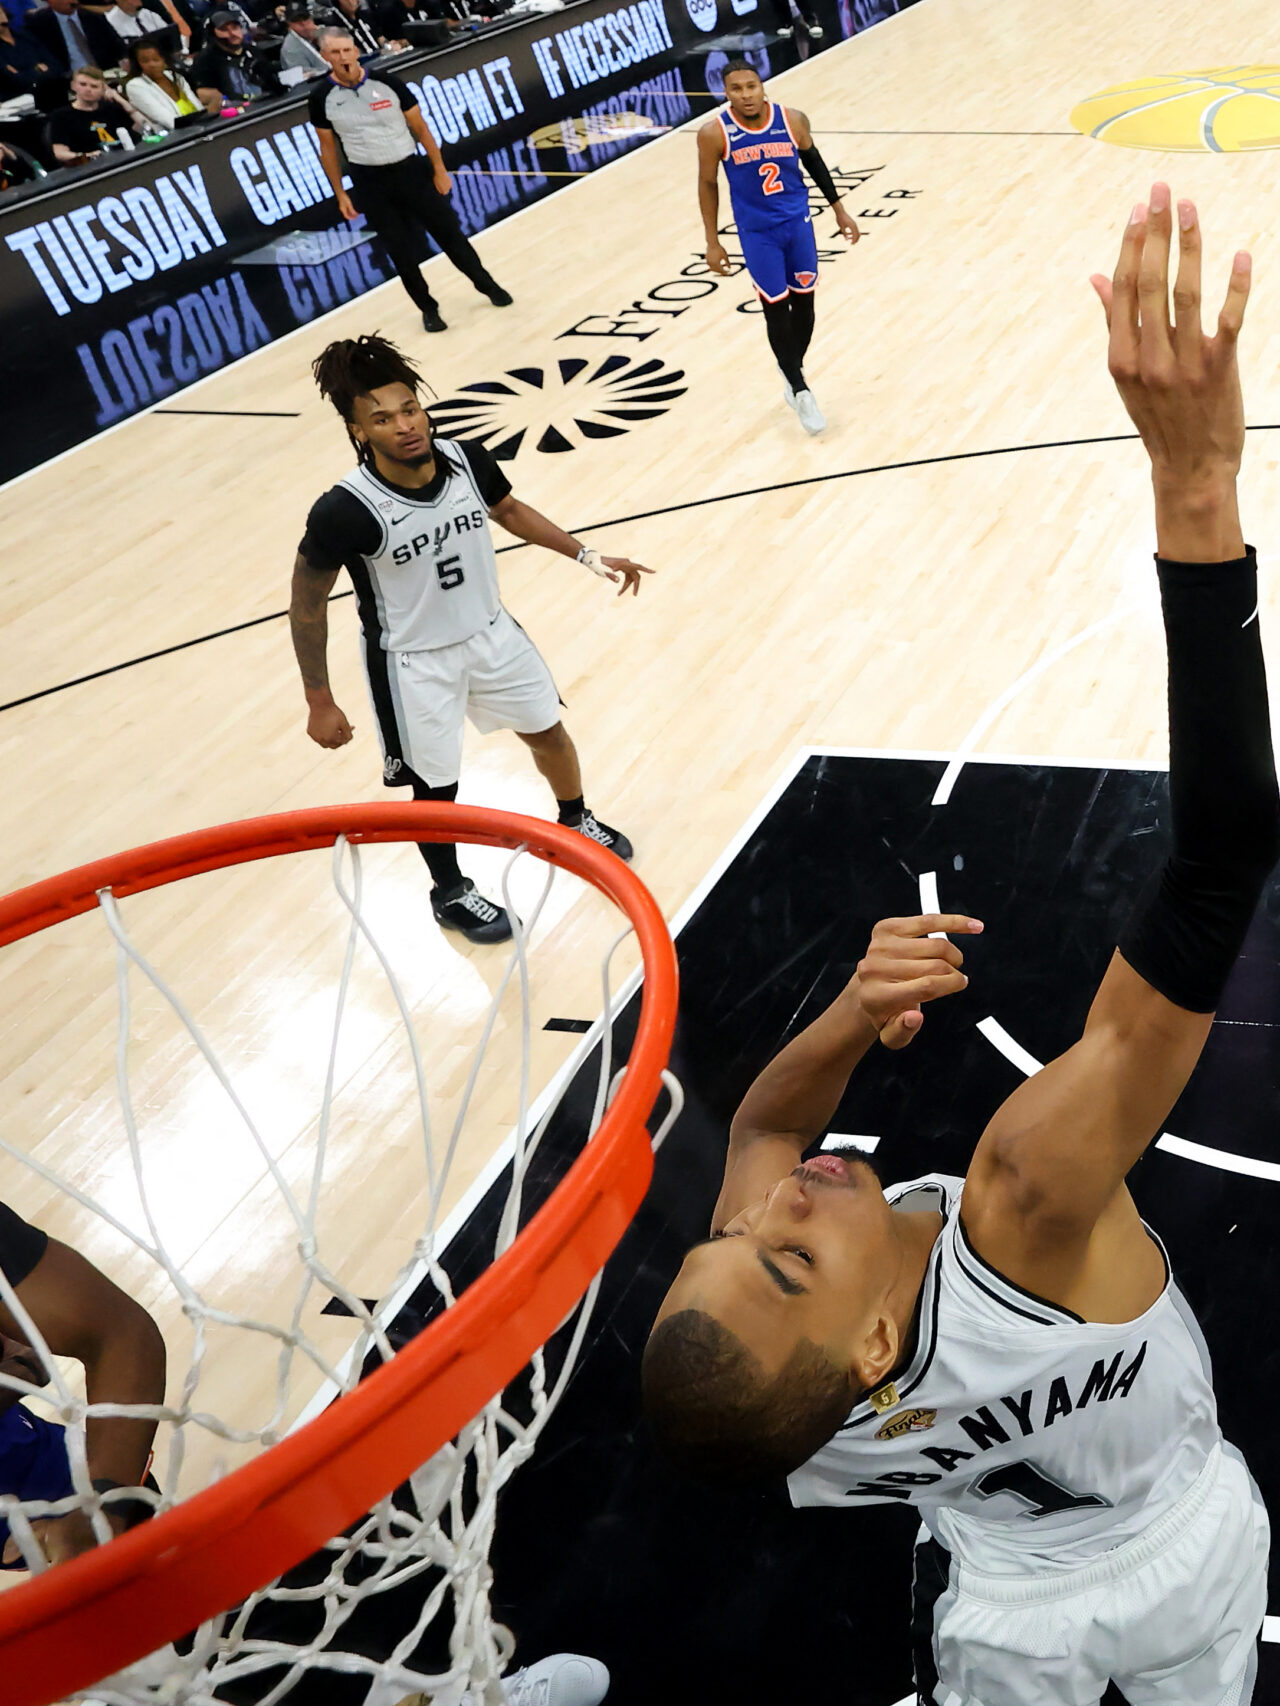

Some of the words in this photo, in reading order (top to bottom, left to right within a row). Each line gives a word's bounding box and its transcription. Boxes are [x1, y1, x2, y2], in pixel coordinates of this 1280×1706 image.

[4, 164, 228, 316] TUESDAY
[230, 121, 353, 226] GAM
[482, 56, 525, 121] ET
[531, 37, 566, 100] IF
[555, 0, 675, 90] NECESSARY
[731, 148, 762, 165] NEW
[758, 142, 795, 159] YORK
[758, 162, 784, 196] 2
[736, 187, 925, 313] CNTER
[436, 555, 465, 590] 5
[967, 1458, 1114, 1522] 1
